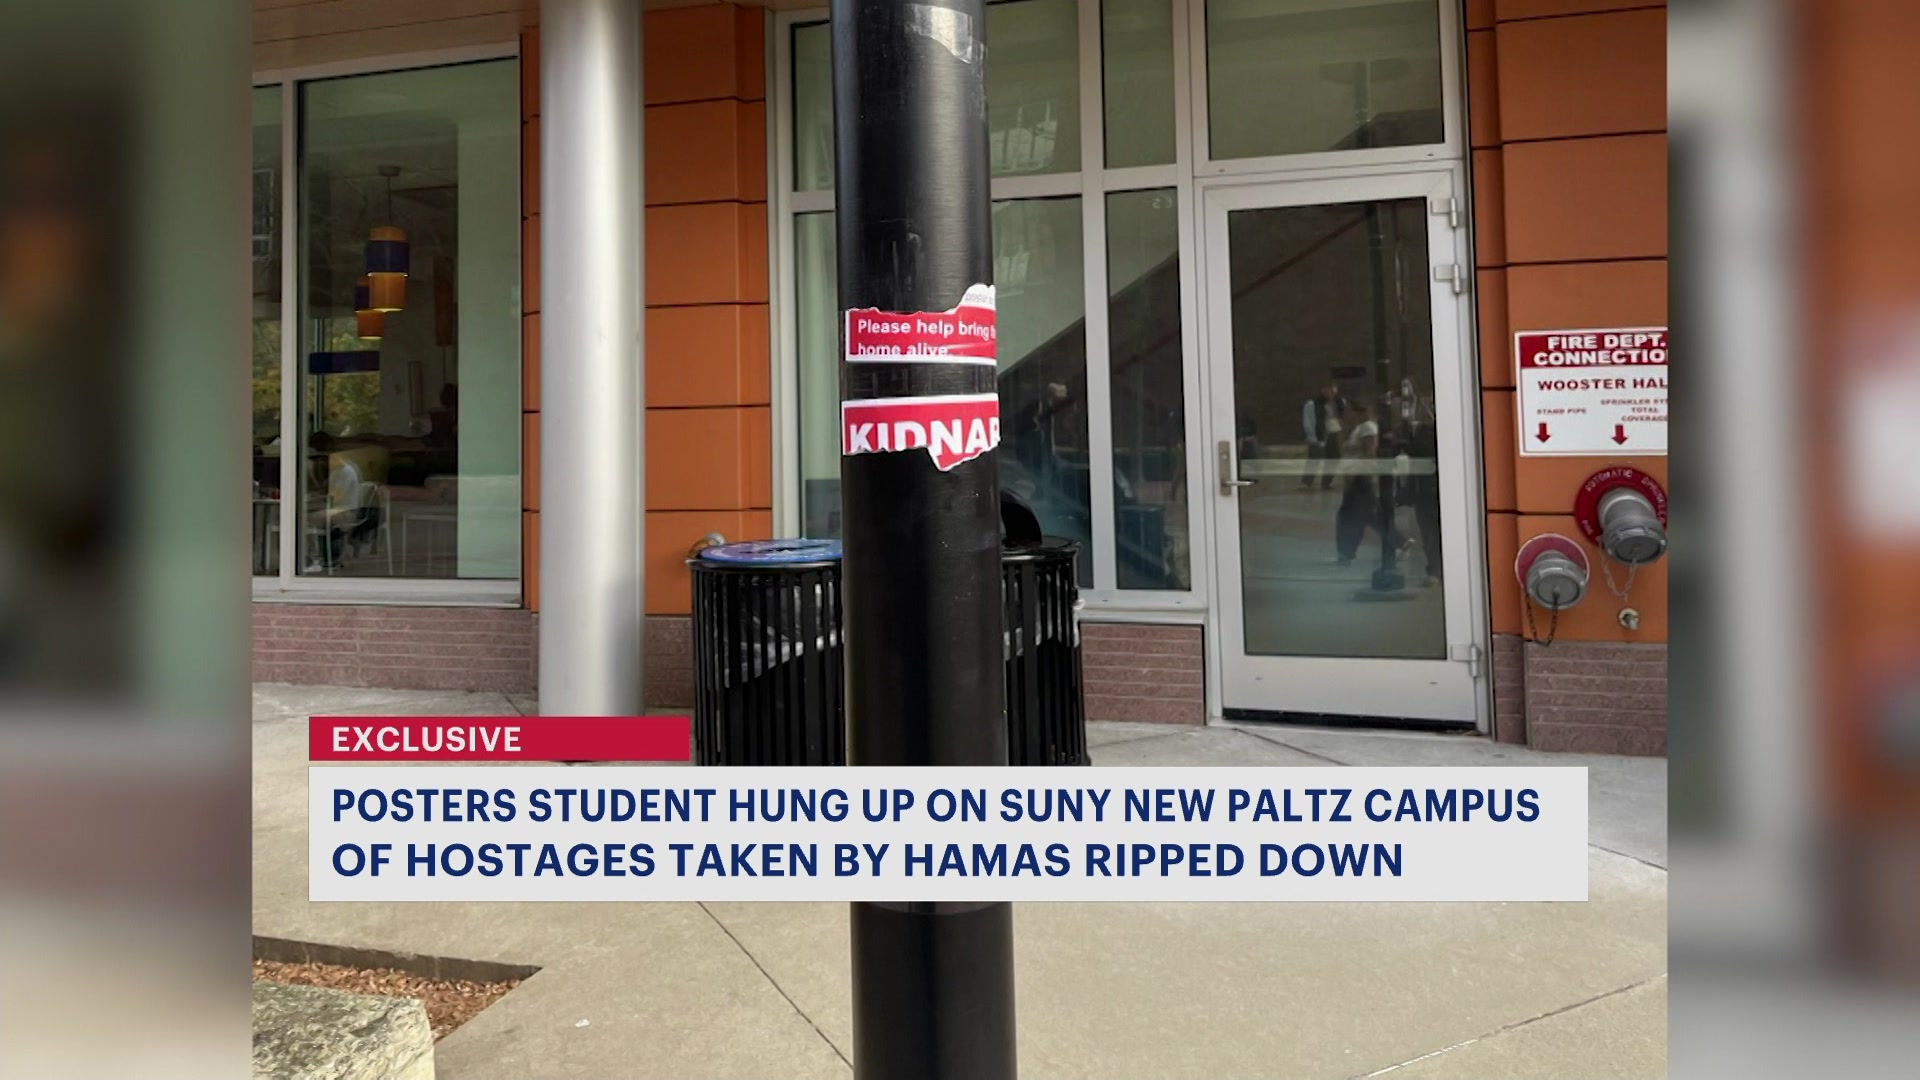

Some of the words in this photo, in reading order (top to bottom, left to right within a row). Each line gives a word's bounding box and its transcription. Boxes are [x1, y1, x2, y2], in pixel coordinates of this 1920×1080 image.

[857, 318, 911, 334] Please
[916, 319, 954, 338] help
[958, 321, 989, 341] bring
[857, 342, 902, 356] home
[1547, 335, 1598, 350] FIRE
[1603, 333, 1667, 348] DEPT.
[1533, 348, 1668, 366] CONNECTIO
[1537, 378, 1626, 391] WOOSTER
